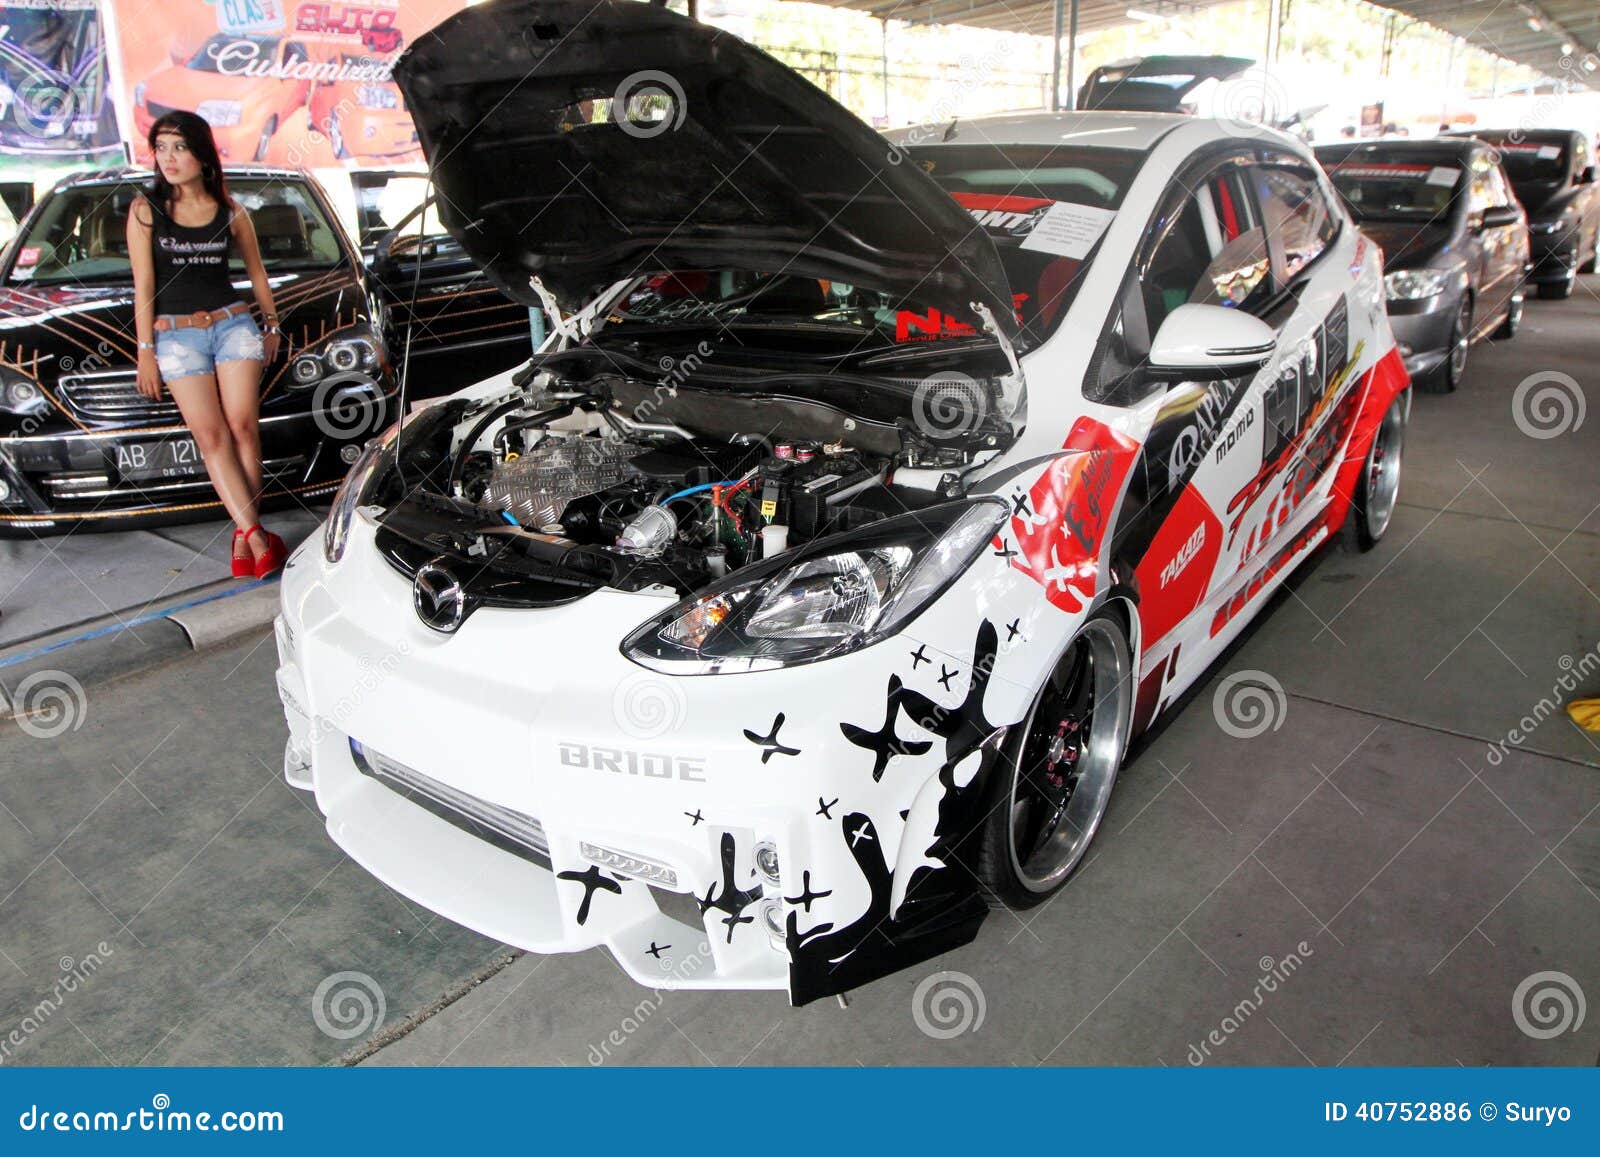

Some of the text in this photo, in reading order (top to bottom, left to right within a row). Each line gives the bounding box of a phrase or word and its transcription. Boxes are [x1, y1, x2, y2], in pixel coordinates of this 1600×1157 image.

[118, 444, 146, 468] AB
[1160, 519, 1206, 590] TAKATA
[558, 742, 706, 782] BRIDE
